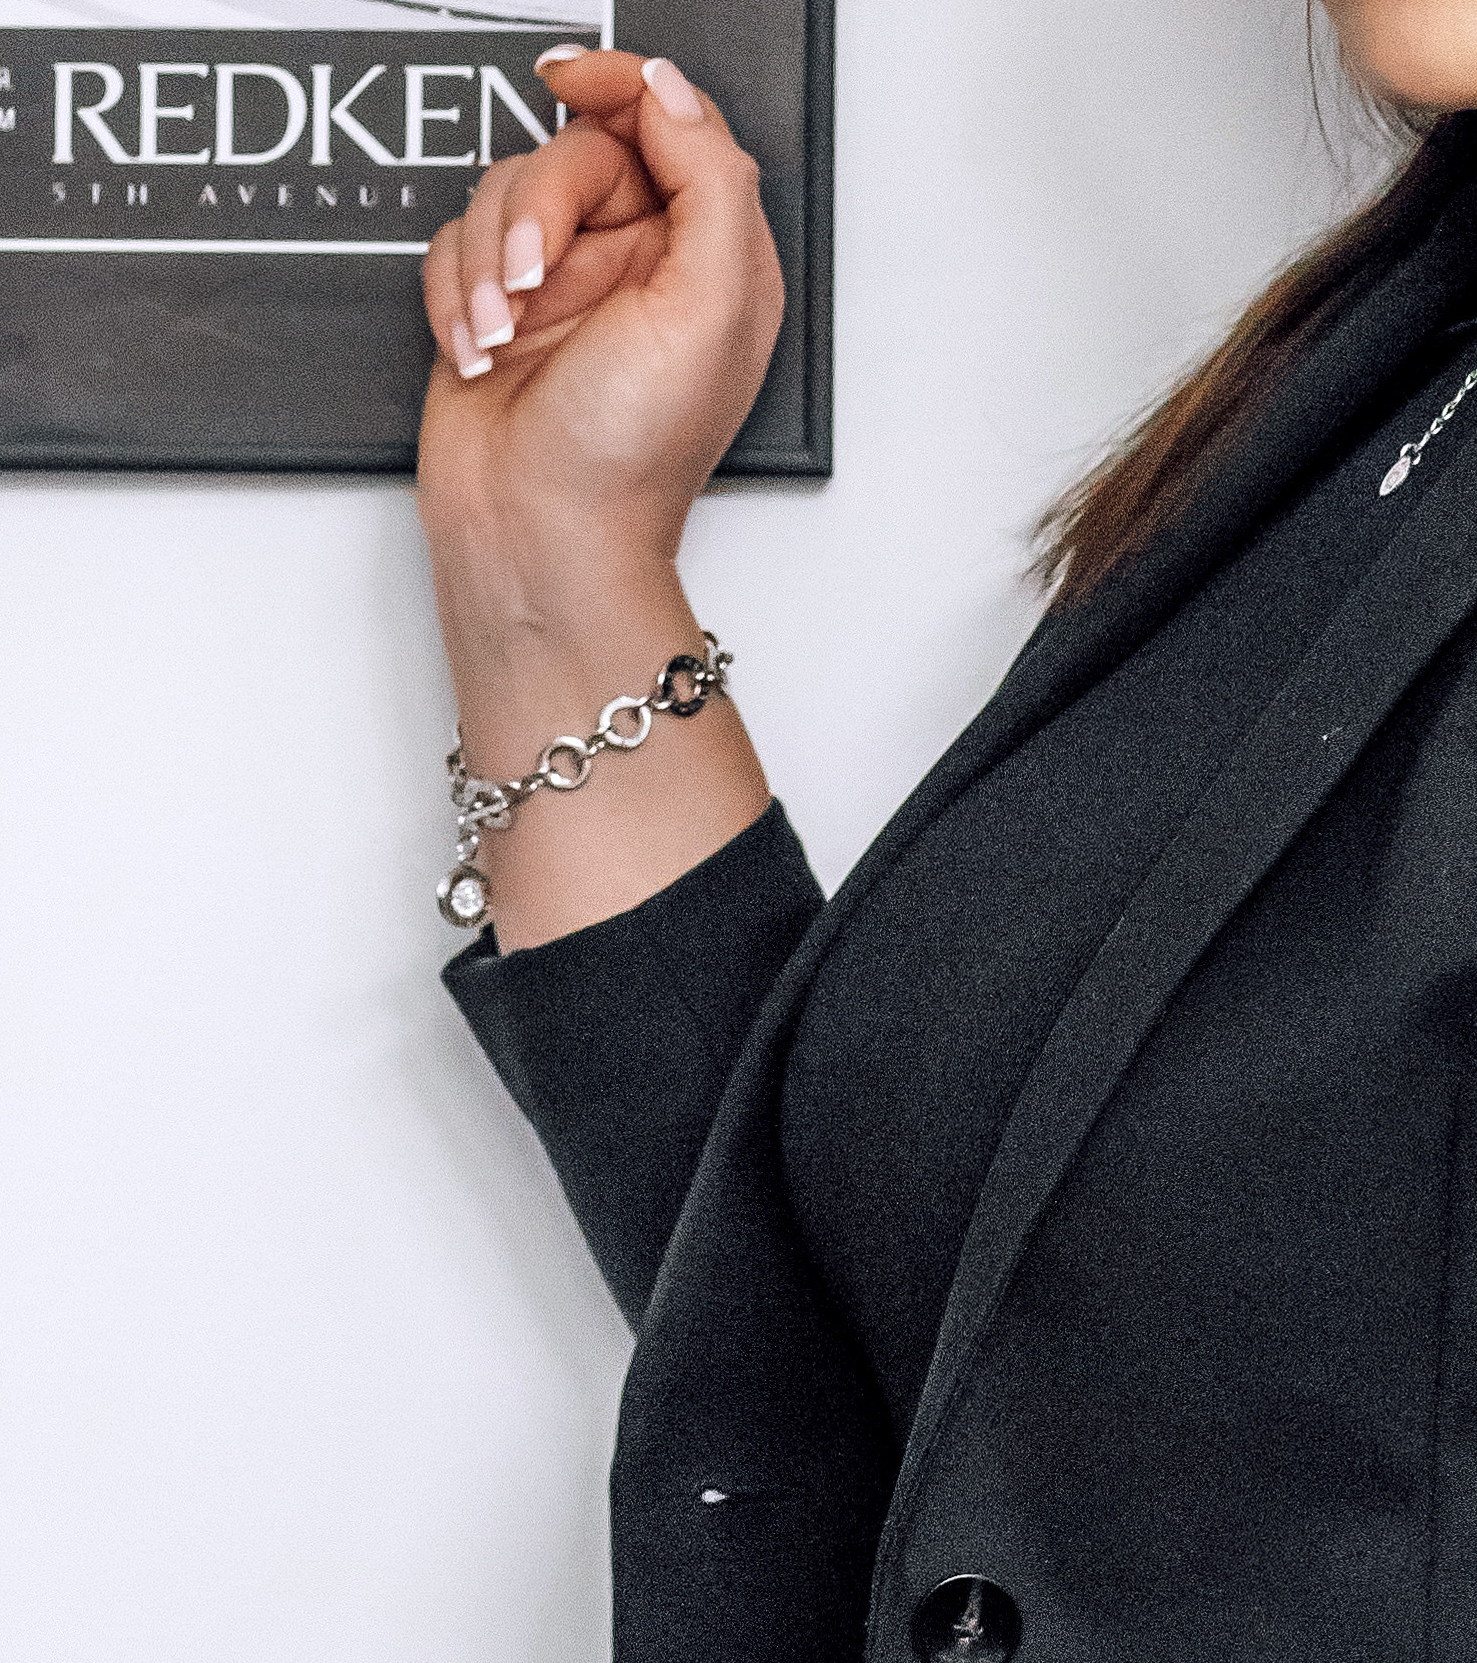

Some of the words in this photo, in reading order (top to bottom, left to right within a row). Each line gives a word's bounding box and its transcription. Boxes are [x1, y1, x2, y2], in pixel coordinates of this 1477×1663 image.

[52, 62, 568, 167] REDKEN
[51, 182, 150, 207] 5TH
[198, 184, 417, 209] AVENUE
